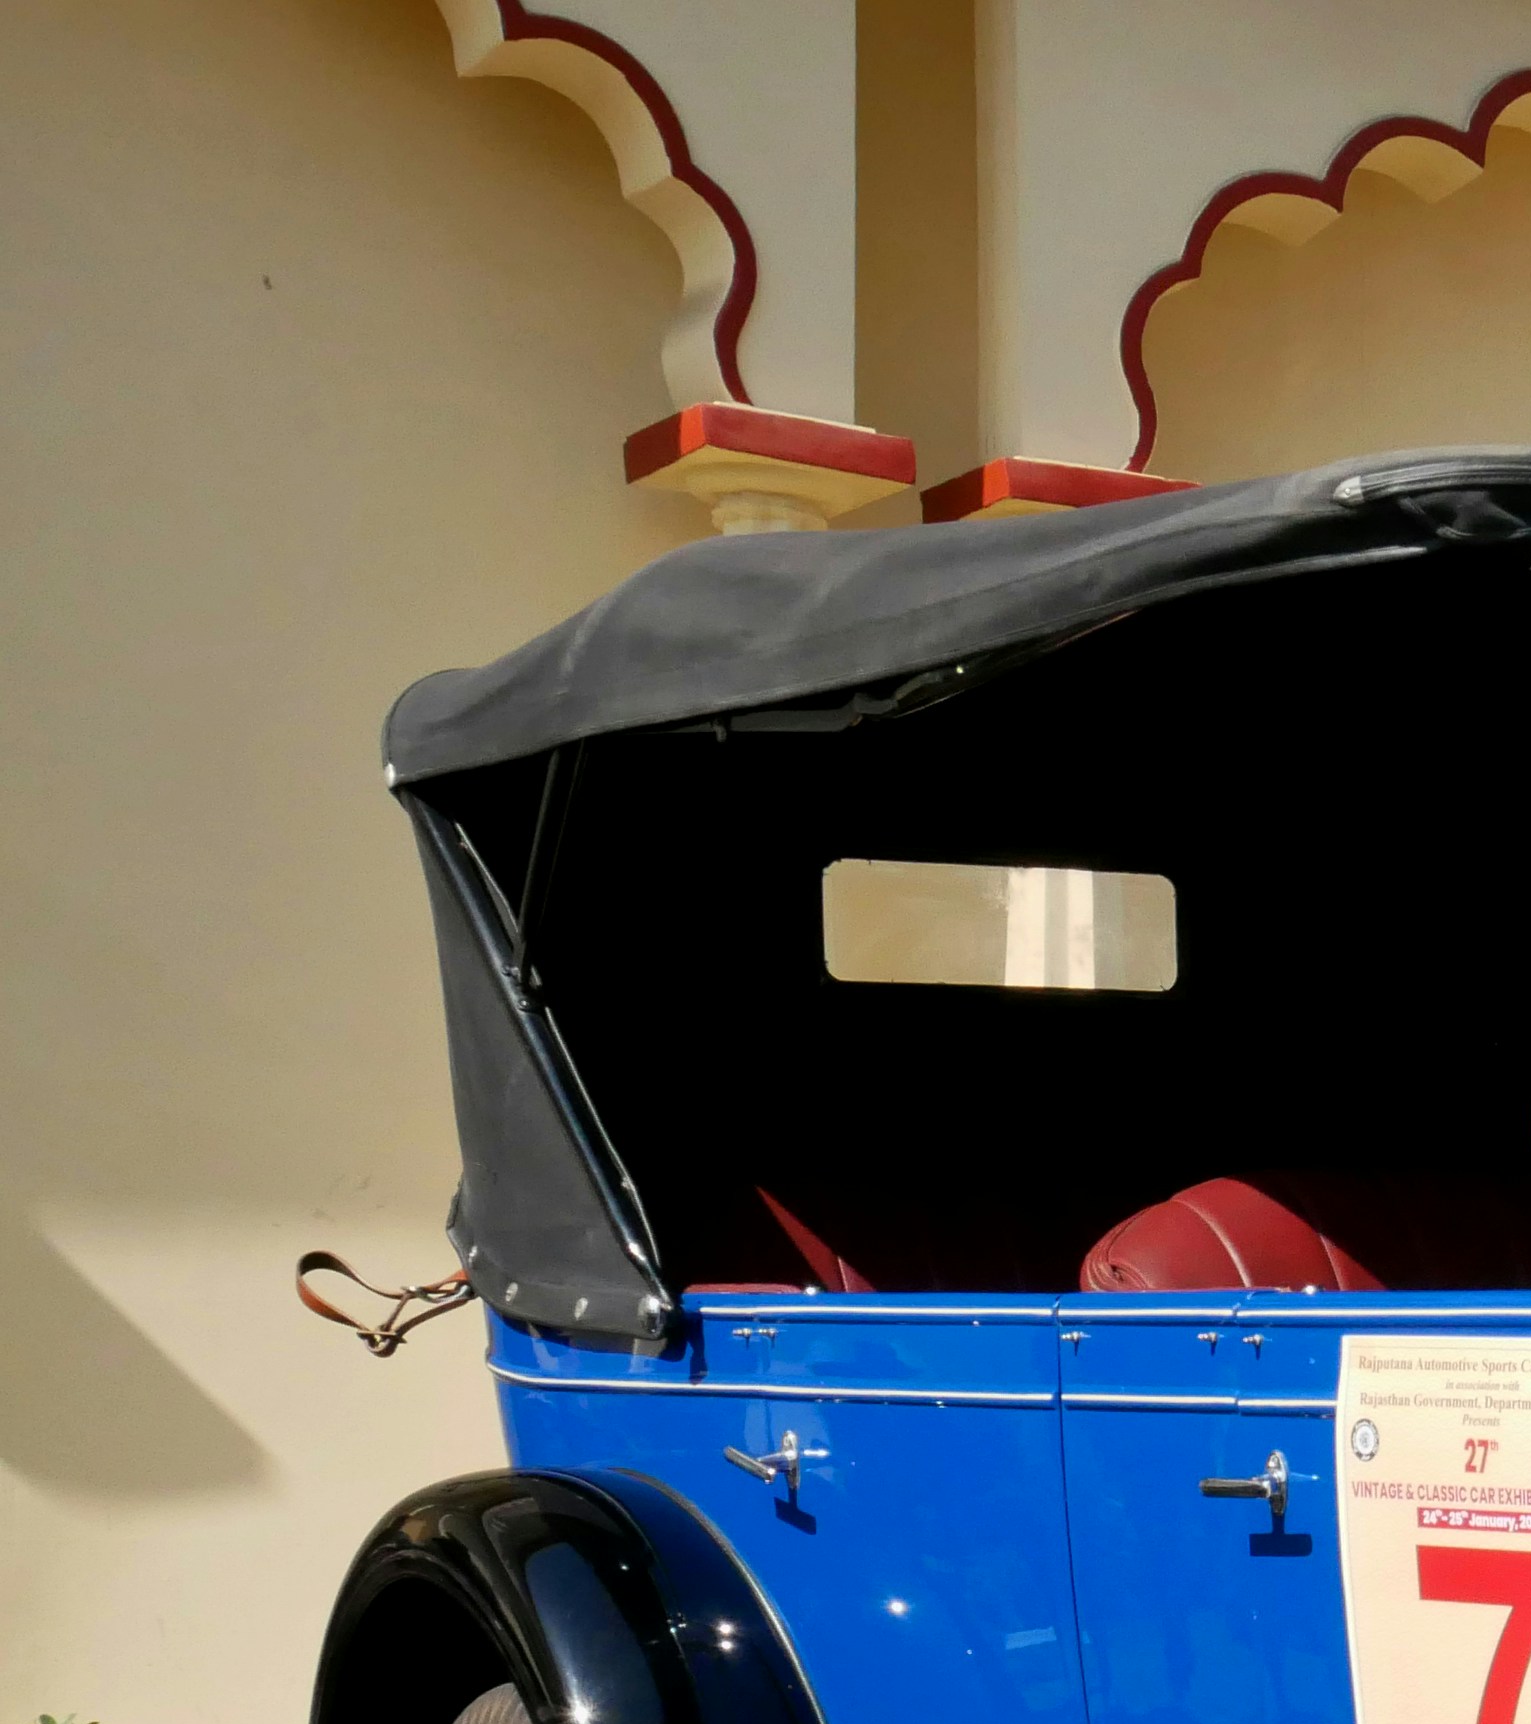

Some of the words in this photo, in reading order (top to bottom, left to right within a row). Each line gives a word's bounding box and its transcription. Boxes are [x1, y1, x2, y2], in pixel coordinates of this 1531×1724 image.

[1358, 1356, 1413, 1373] Rajputana
[1416, 1357, 1478, 1372] Automotive
[1481, 1358, 1518, 1376] Sports
[1445, 1380, 1454, 1390] in
[1455, 1380, 1500, 1391] association
[1502, 1380, 1520, 1391] with
[1359, 1392, 1411, 1409] Rajasthan
[1462, 1414, 1500, 1427] Presents
[1352, 1481, 1403, 1500] VINTAGE
[1406, 1483, 1414, 1500] &
[1417, 1484, 1467, 1503] CLASSIC
[1470, 1486, 1495, 1505] CAR
[1469, 1513, 1519, 1532] January,
